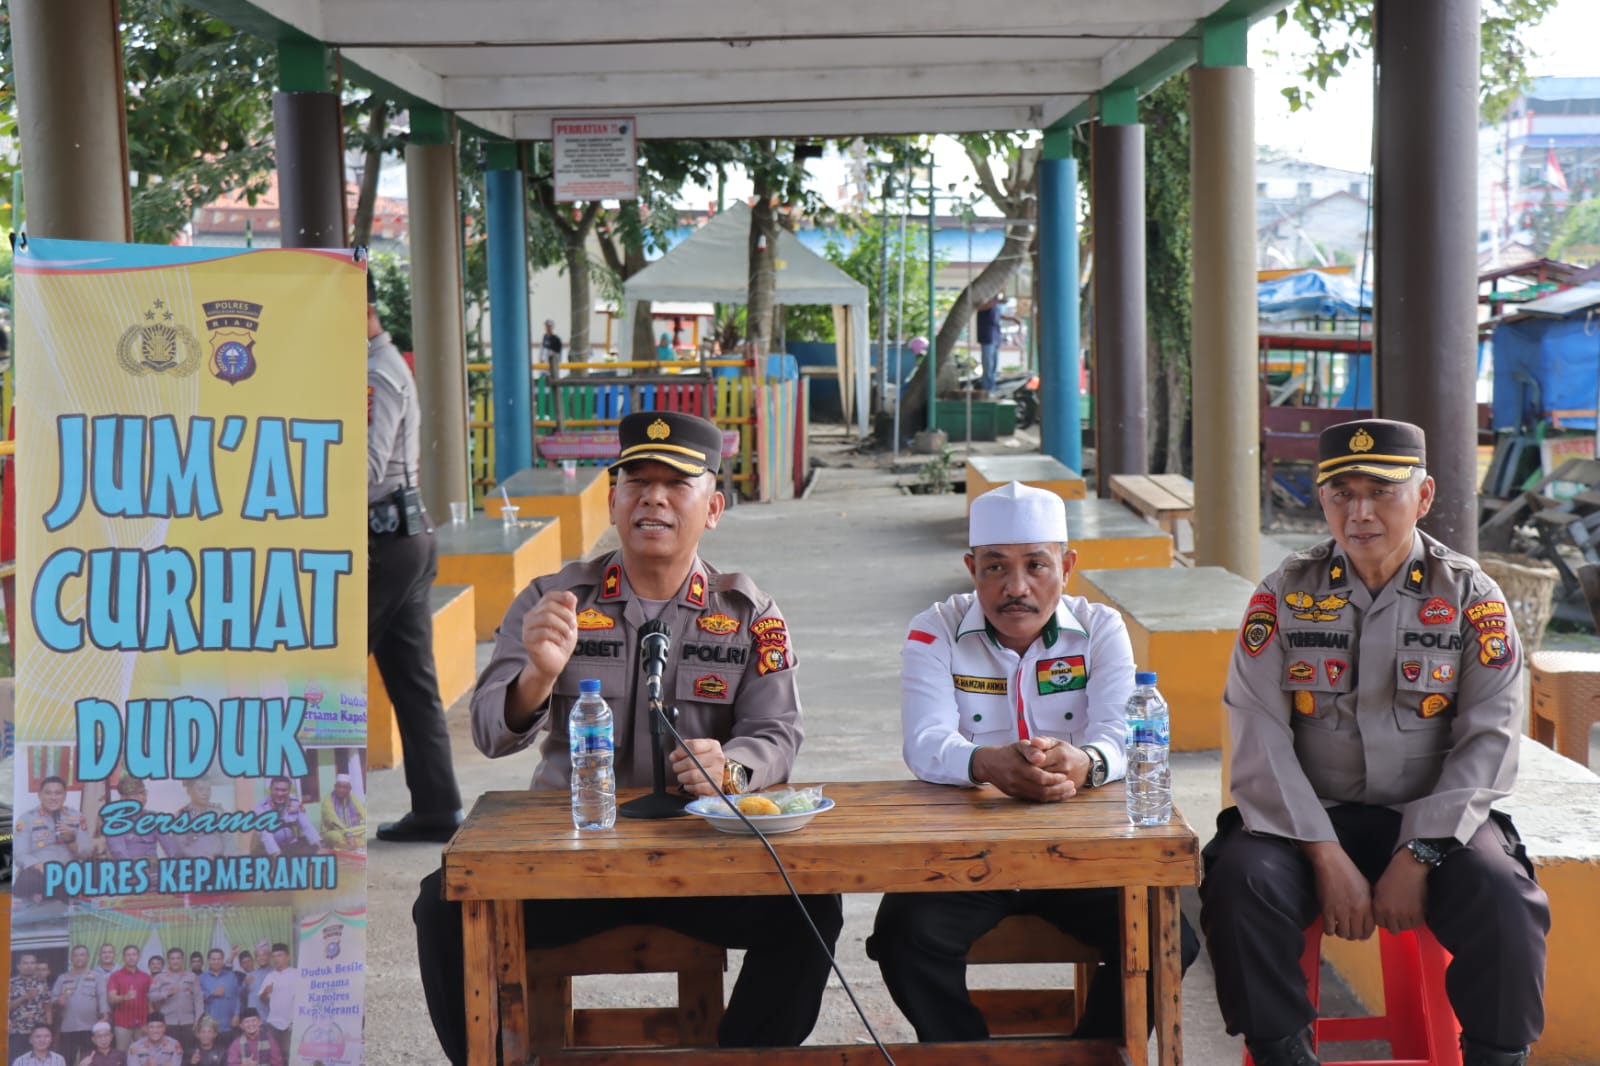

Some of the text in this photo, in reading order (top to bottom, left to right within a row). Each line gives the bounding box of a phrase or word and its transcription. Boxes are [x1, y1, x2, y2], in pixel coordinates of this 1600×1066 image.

[212, 319, 253, 328] RIAU
[215, 302, 249, 311] POLRES
[43, 413, 343, 532] JUM'AT
[31, 545, 353, 655] CURHAT
[1478, 619, 1504, 629] RIAU
[682, 643, 748, 665] POLRI
[75, 696, 309, 782] DUDUK
[98, 799, 284, 836] Bersama
[45, 854, 337, 898] POLRES KEP.MERANTI
